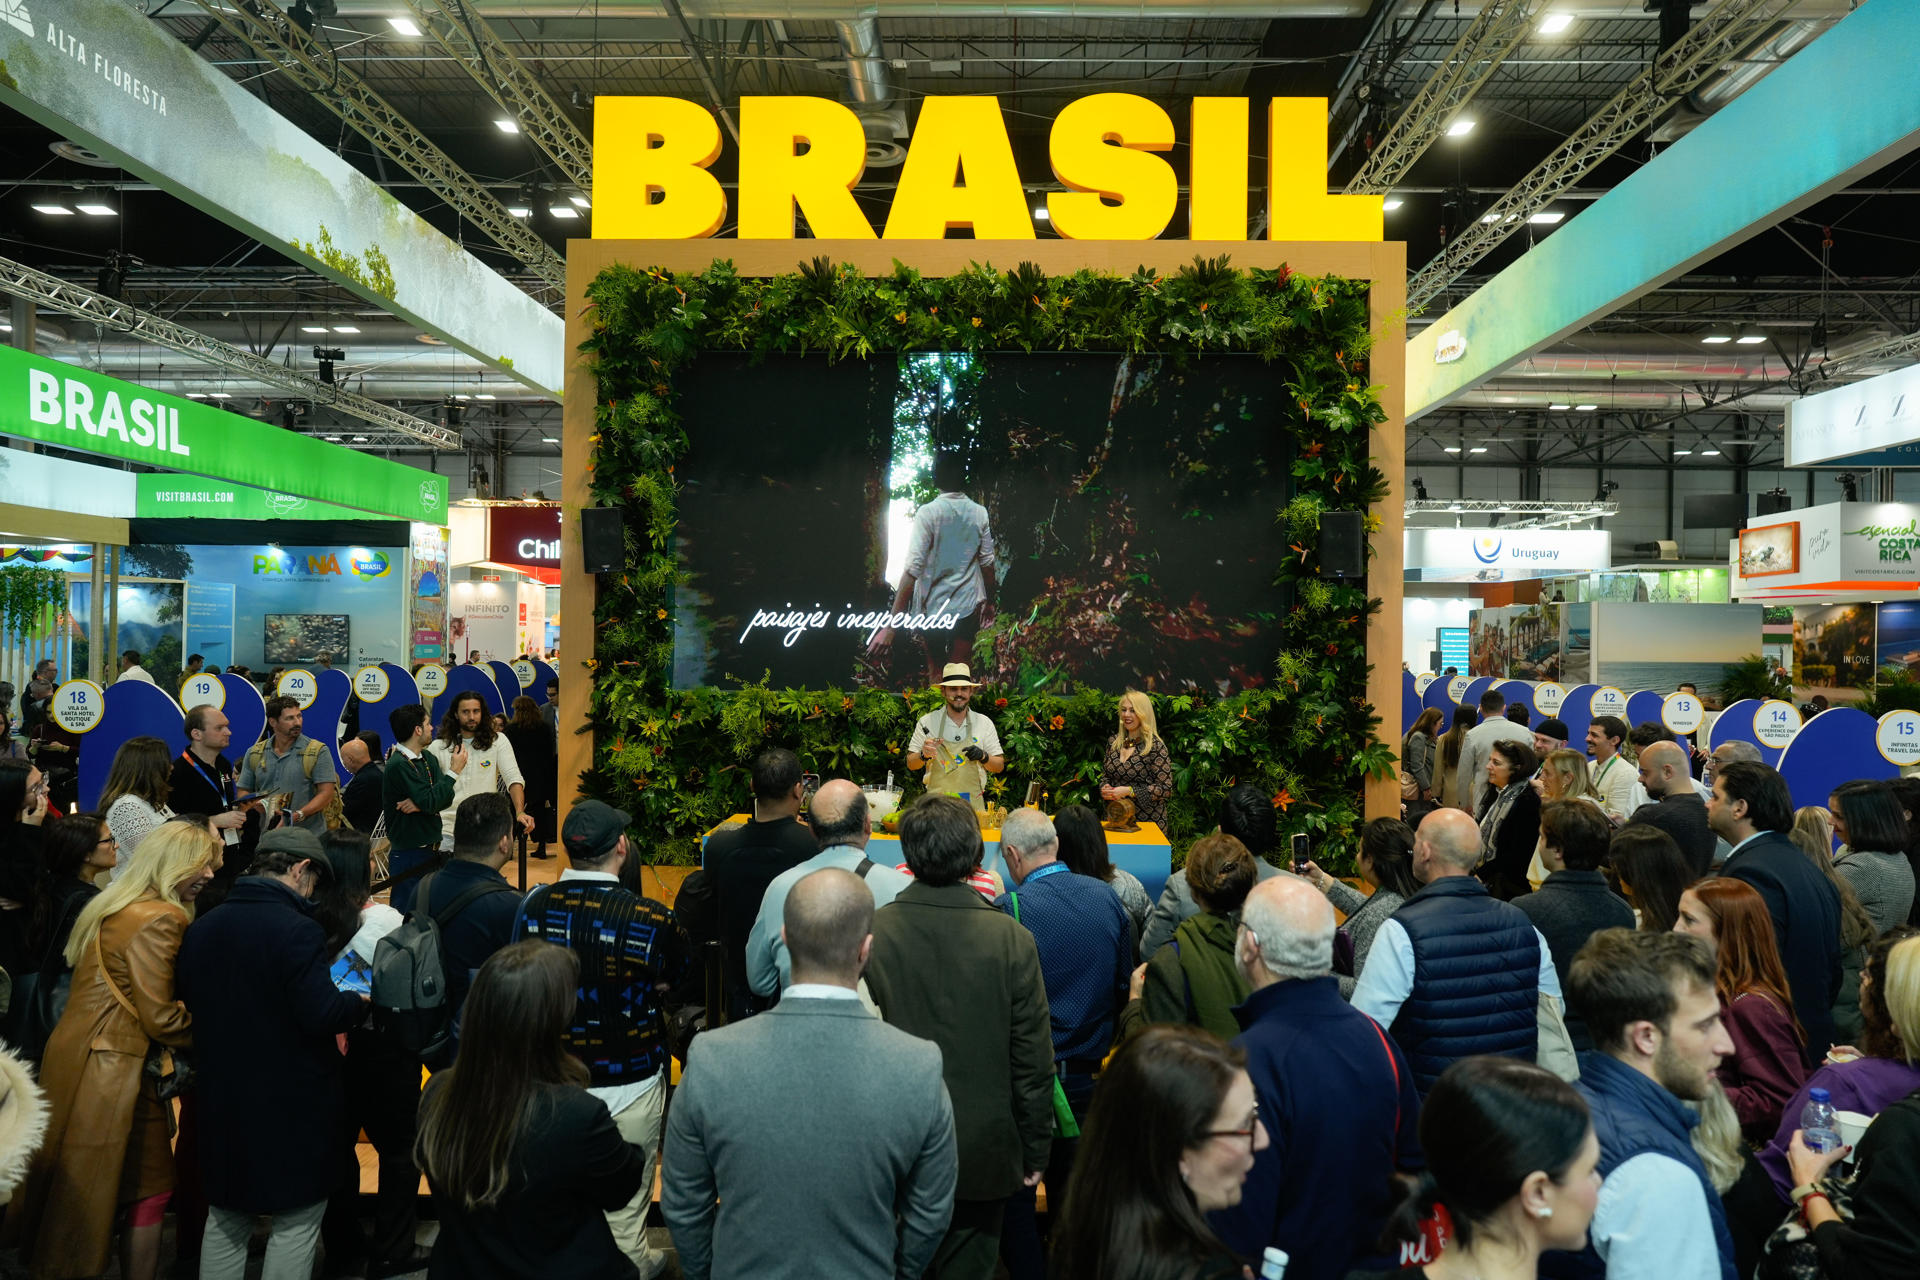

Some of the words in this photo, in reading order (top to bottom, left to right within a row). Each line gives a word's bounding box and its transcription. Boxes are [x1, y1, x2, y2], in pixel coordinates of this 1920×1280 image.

[47, 23, 86, 65] ALTA
[94, 52, 167, 117] FLORESTA
[591, 92, 1385, 242] BRASIL
[29, 368, 190, 456] BRASIL
[156, 491, 234, 503] VISITBRASIL.COM
[518, 539, 561, 559] Chil
[1879, 538, 1920, 550] COSTA
[1512, 548, 1560, 560] Uruguay
[1879, 550, 1912, 561] RICA
[253, 552, 342, 575] PARANÁ
[465, 604, 510, 613] INFINITO
[739, 602, 831, 647] paisajes
[836, 598, 961, 646] inesperados
[1843, 655, 1851, 664] IN
[1852, 655, 1871, 664] LOVE
[518, 665, 528, 673] 24
[365, 673, 376, 683] 21
[425, 671, 436, 680] 22
[195, 683, 210, 695] 19
[291, 678, 304, 689] 20
[1457, 681, 1467, 689] 09
[69, 691, 86, 704] 18
[1546, 689, 1556, 698] 11
[1603, 693, 1616, 702] 12
[1677, 701, 1690, 711] 13
[1771, 710, 1787, 722] 14
[1896, 721, 1914, 735] 15
